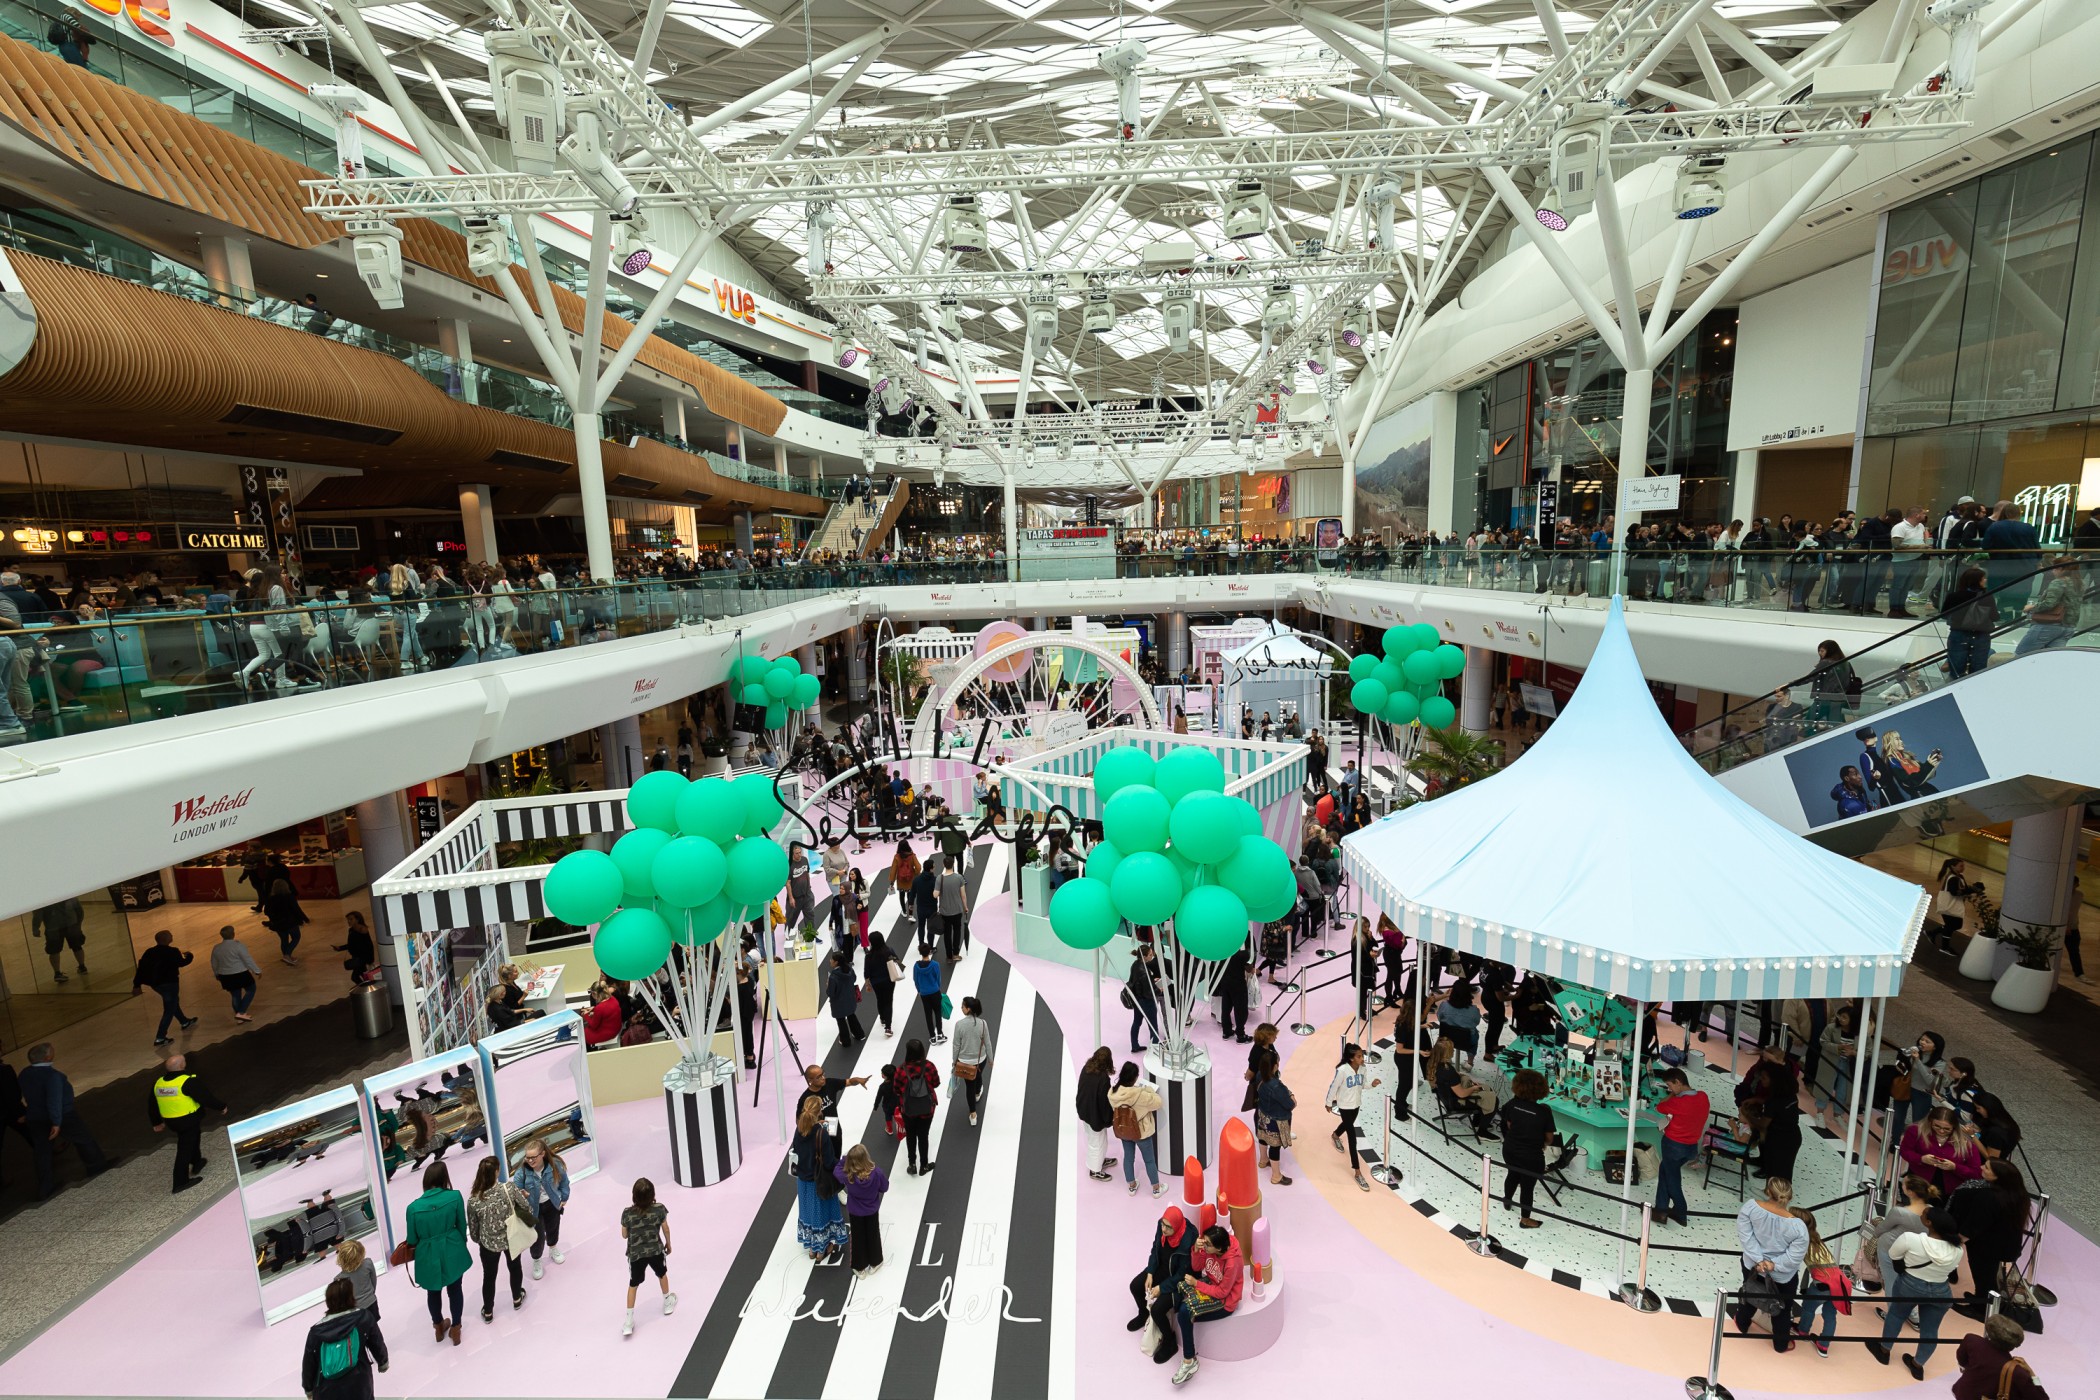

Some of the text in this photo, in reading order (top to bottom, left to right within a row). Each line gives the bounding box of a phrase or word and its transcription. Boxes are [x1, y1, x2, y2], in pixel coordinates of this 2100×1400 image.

[1541, 488, 1547, 497] 2
[187, 533, 266, 548] CATCH ME
[1027, 529, 1054, 540] TAPAS
[171, 786, 256, 827] Westfield
[429, 806, 437, 817] 8
[173, 815, 239, 843] LONDON W12
